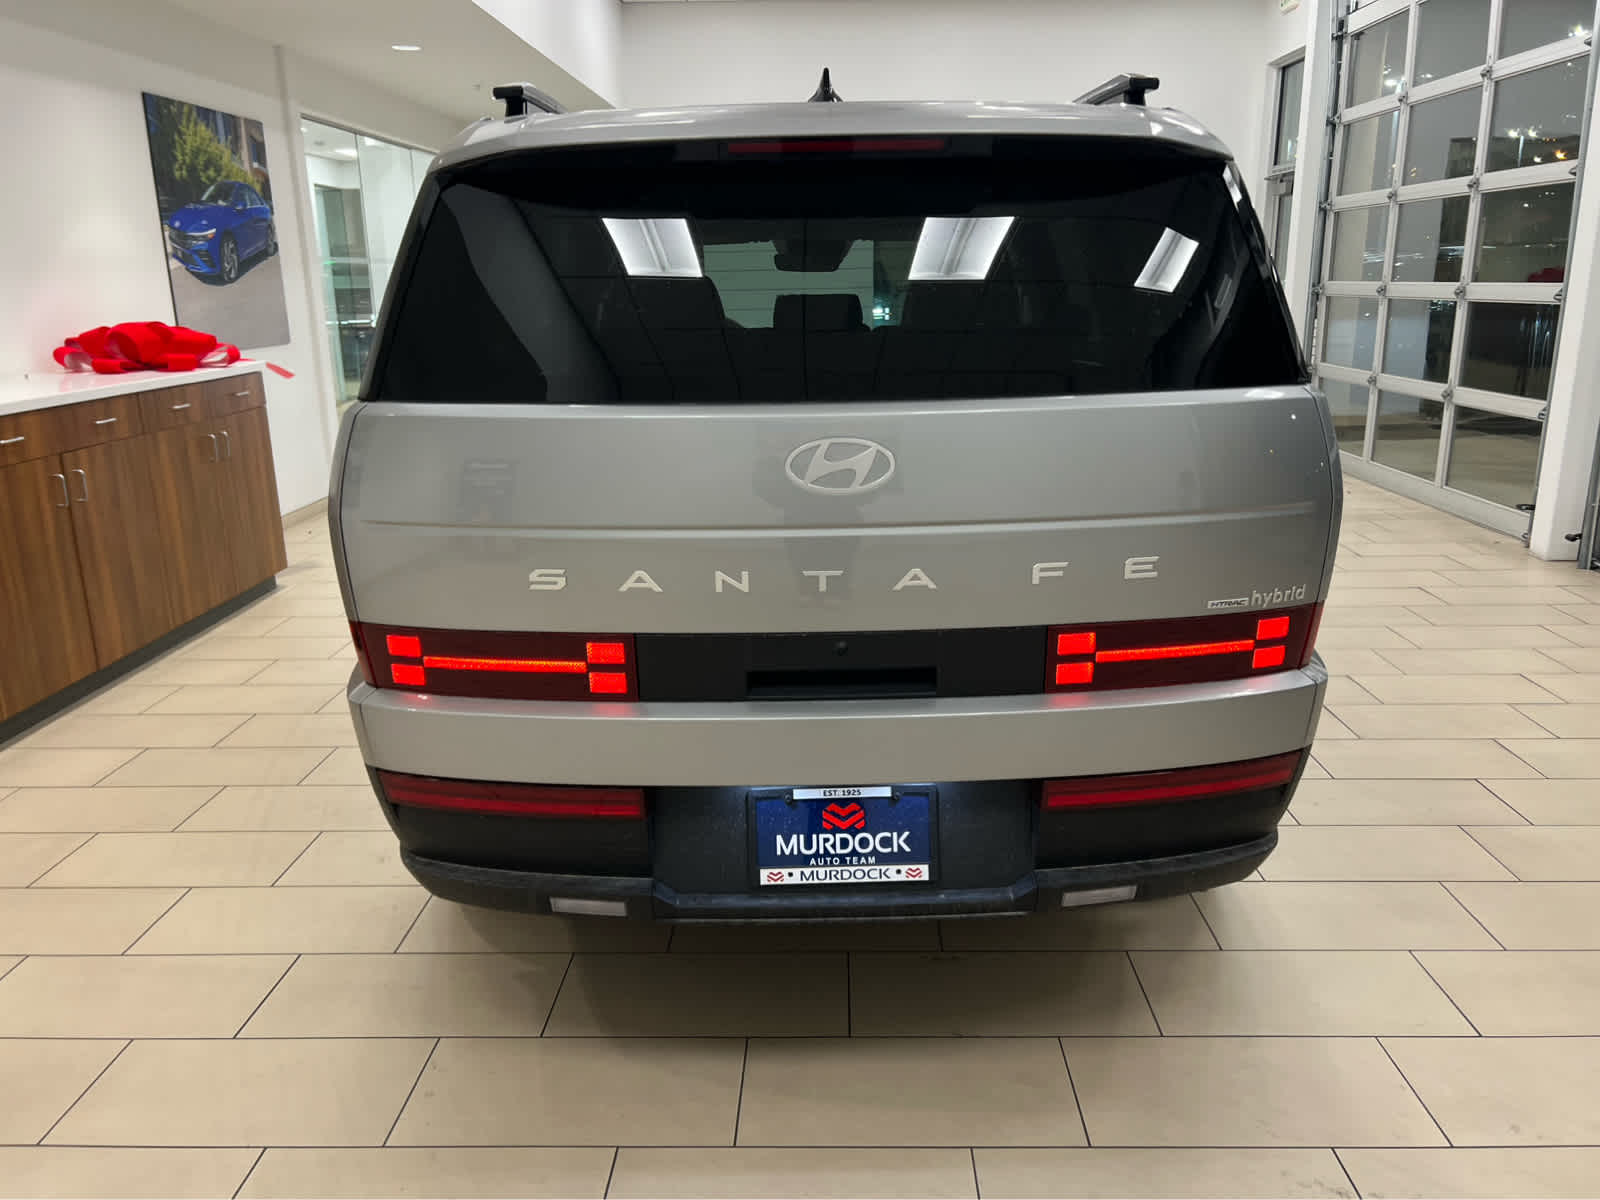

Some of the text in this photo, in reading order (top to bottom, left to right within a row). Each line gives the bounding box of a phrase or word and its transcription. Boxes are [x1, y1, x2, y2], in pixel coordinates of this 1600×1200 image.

[528, 556, 1160, 593] SANTA FE
[1251, 584, 1306, 608] hybrid
[776, 831, 911, 856] MURDOCK
[809, 856, 876, 866] AUTO TEAM
[800, 867, 891, 881] MURDOCK
